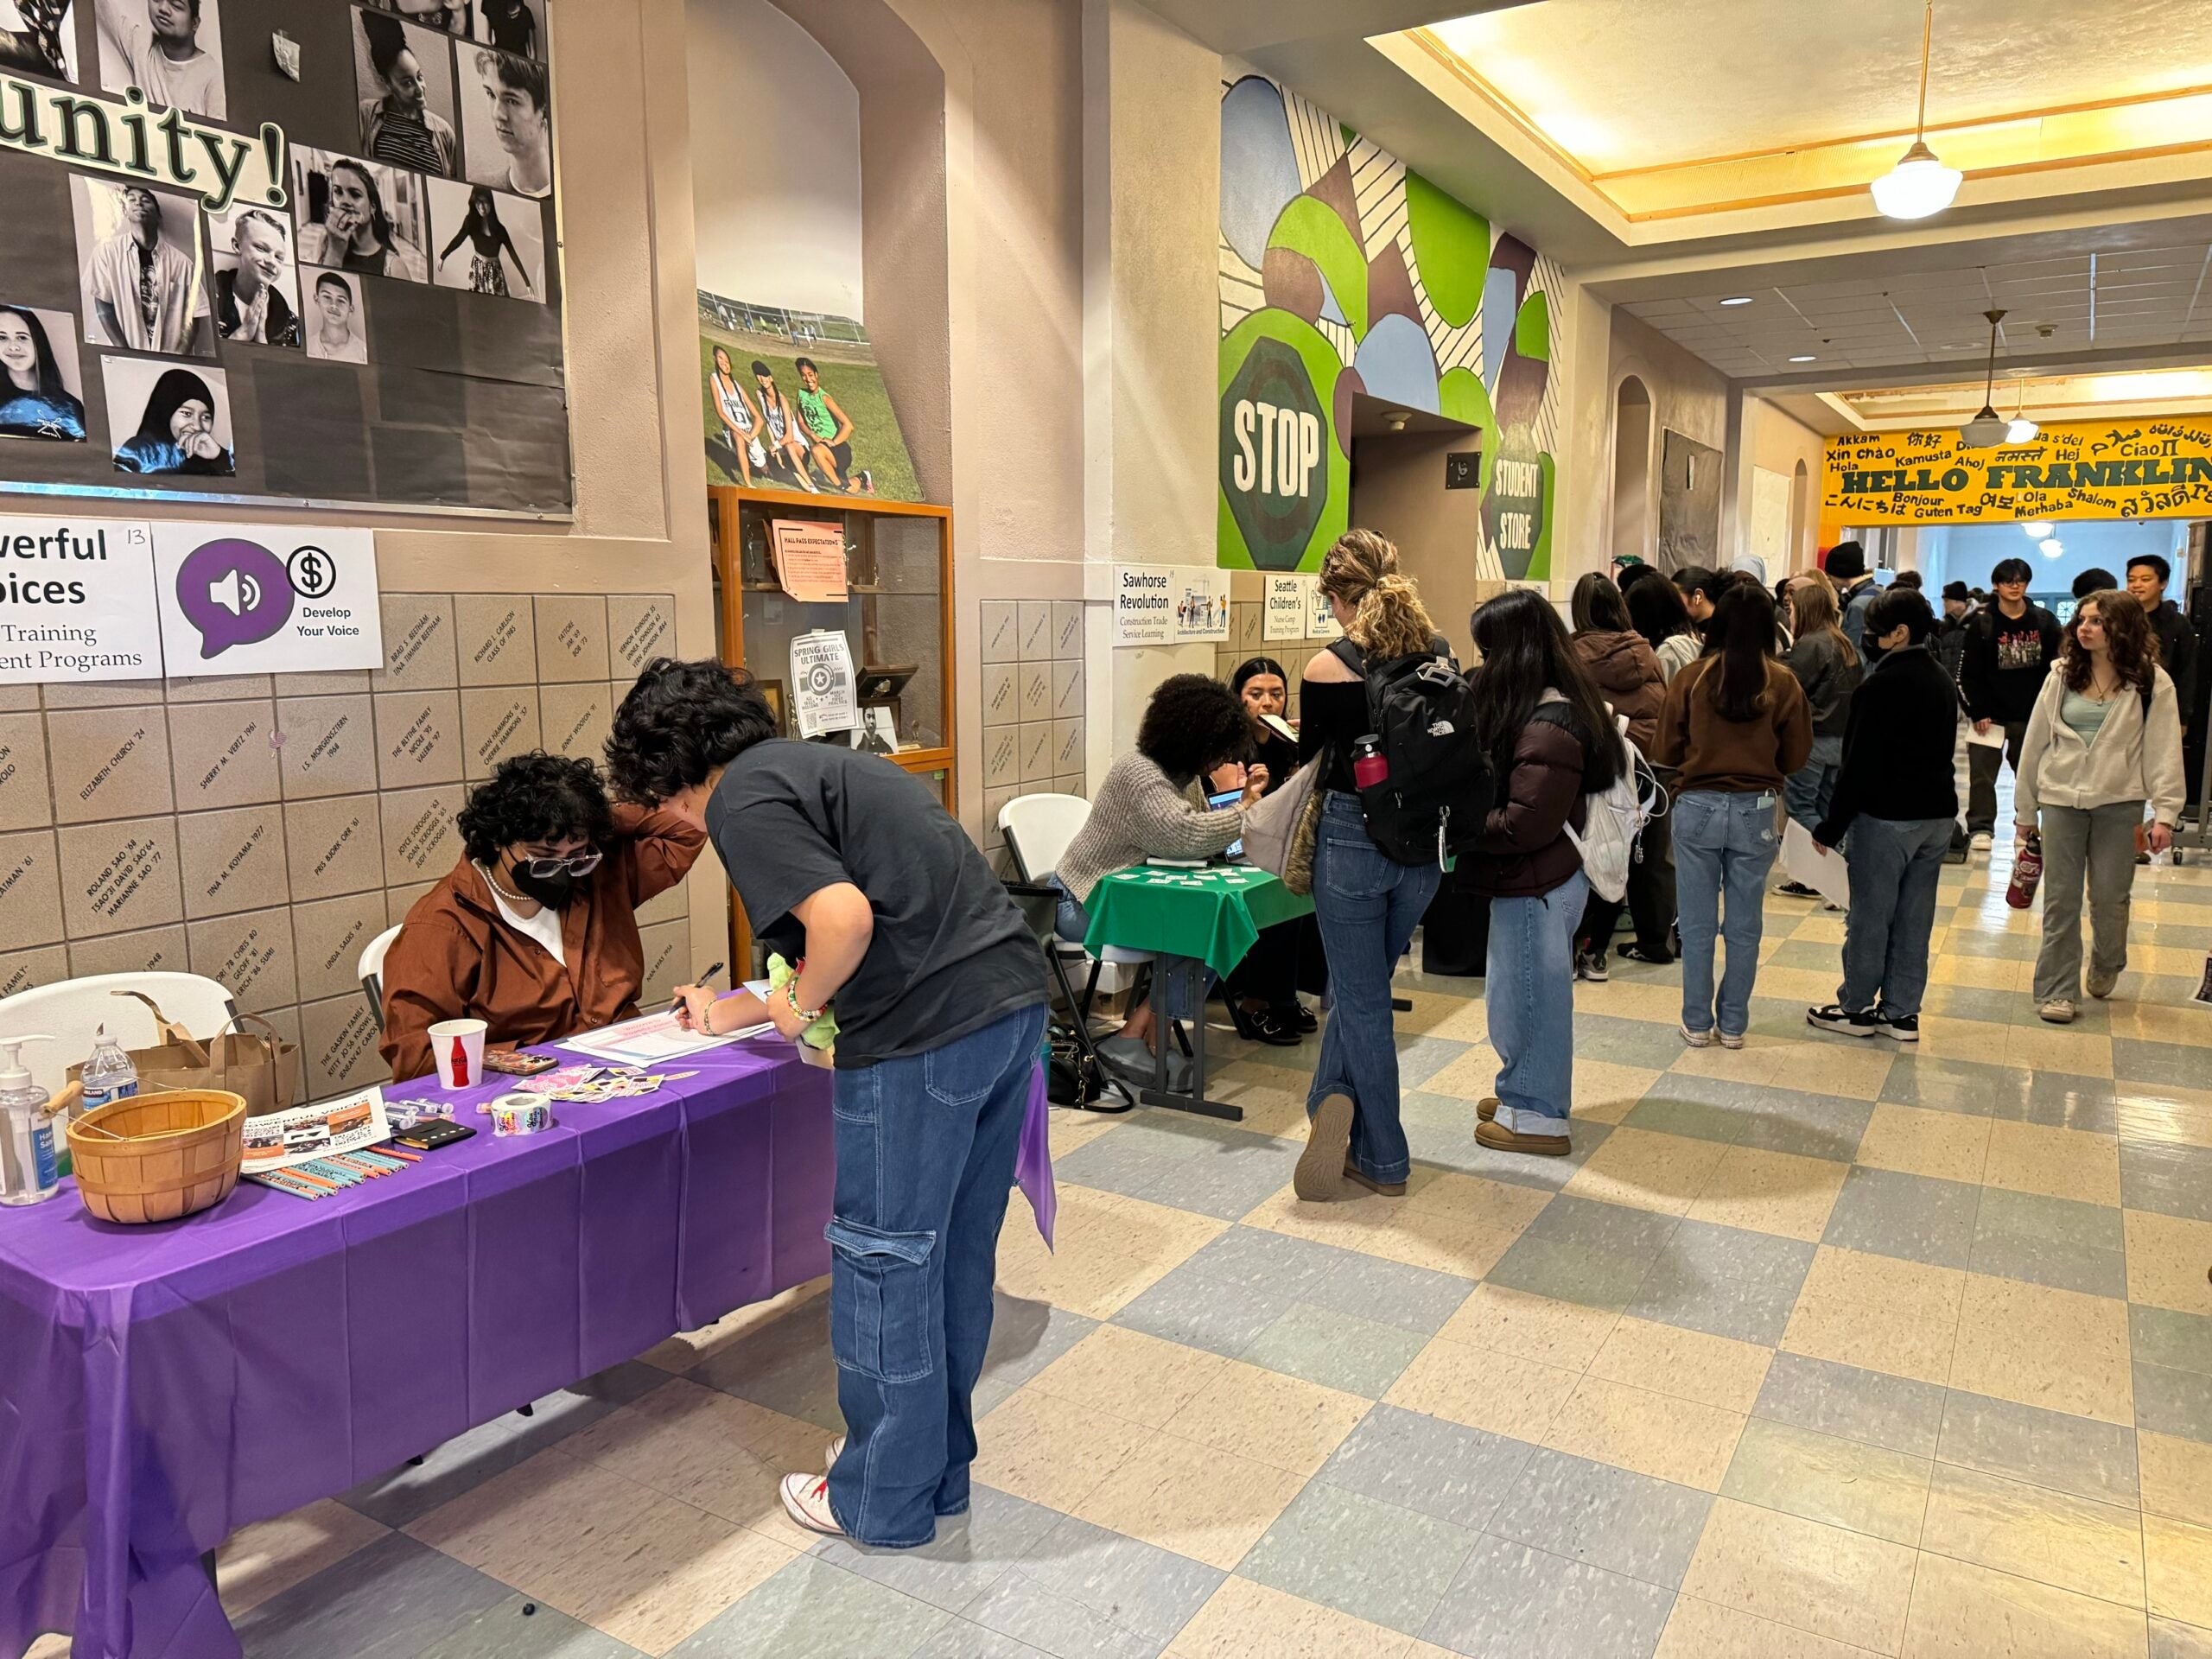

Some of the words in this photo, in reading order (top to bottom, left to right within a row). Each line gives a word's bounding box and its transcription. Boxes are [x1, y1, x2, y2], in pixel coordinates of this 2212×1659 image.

[1233, 398, 1319, 498] STOP
[1837, 434, 1880, 447] Akkam
[1906, 432, 1942, 448] 你好
[2120, 442, 2159, 456] Ciao
[1827, 448, 1850, 461] Xin
[1895, 450, 1952, 467] Kamusta
[1955, 456, 1985, 471] Ahoj
[1995, 446, 2048, 462] नमस्ते
[2056, 448, 2080, 461] Hej
[1830, 461, 1859, 472] Hola
[1495, 458, 1539, 499] STUDENT
[1841, 467, 1969, 493] HELLO
[1825, 493, 1906, 515] こんにちは
[1892, 492, 1944, 506] Bonjour
[2014, 499, 2074, 518] Merhaba
[2067, 487, 2117, 509] Shalom
[1914, 506, 1953, 518] Guten
[1956, 504, 1983, 517] Tag
[127, 529, 146, 544] 13
[1499, 513, 1532, 550] STORE
[1122, 572, 1166, 588] Sawhorse
[1274, 579, 1297, 592] Seattle
[1120, 594, 1169, 609] Revolution
[1270, 596, 1301, 609] Children's
[302, 607, 352, 620] Develop
[1120, 616, 1153, 626] Construction
[1154, 616, 1167, 626] Trade
[1, 624, 97, 647] Training
[296, 625, 323, 637] Your
[327, 625, 360, 636] Voice
[474, 639, 492, 663] RICHARD
[496, 611, 515, 635] CARLSON
[1122, 629, 1141, 639] Service
[1141, 629, 1165, 639] Learning
[487, 645, 500, 662] CLASS
[499, 637, 505, 646] OF
[794, 645, 821, 658] SPRING
[823, 644, 844, 653] GIRLS
[800, 652, 840, 664] ULTIMATE
[38, 650, 143, 673] Programs
[393, 662, 405, 676] TINA
[392, 746, 402, 758] THE
[401, 726, 417, 747] BLYTHE
[416, 707, 431, 728] FAMILY
[492, 710, 513, 740] HAMMONS
[499, 716, 521, 745] HAMMONS
[200, 765, 220, 790] SHERRY
[228, 735, 245, 755] VERTZ
[244, 721, 257, 736] 1961
[409, 734, 425, 755] NICOLE
[416, 741, 434, 763] VALERIE
[79, 766, 111, 800] ELIZABETH
[111, 740, 135, 766] CHURCH
[398, 836, 412, 855] JOYCE
[410, 810, 432, 837] SCROGGS
[406, 844, 420, 863] JOAN
[418, 817, 440, 845] SCROGGS
[426, 825, 447, 853] SCROGGS
[207, 880, 221, 897] TINA
[228, 842, 252, 870] KOYAMA
[251, 825, 264, 842] 1977
[315, 861, 326, 876] PRIS
[325, 841, 341, 861] BJORK
[340, 827, 352, 841] ORR
[86, 868, 112, 897] ROLAND
[111, 851, 126, 868] SAO
[125, 839, 137, 850] '68
[114, 865, 133, 887] DAVID
[107, 880, 139, 917] MARIANNE
[137, 864, 152, 880] SAO
[150, 851, 161, 863] '77
[226, 959, 234, 969] 78
[233, 940, 249, 959] CHRIS
[249, 930, 257, 940] 80
[325, 950, 340, 969] LINDA
[233, 957, 250, 980] GEOFF
[236, 976, 252, 996] ERICH
[260, 947, 275, 965] SUMI
[321, 1053, 331, 1066] THE
[330, 1028, 349, 1053] GASKIN
[347, 1006, 364, 1029] FAMILY
